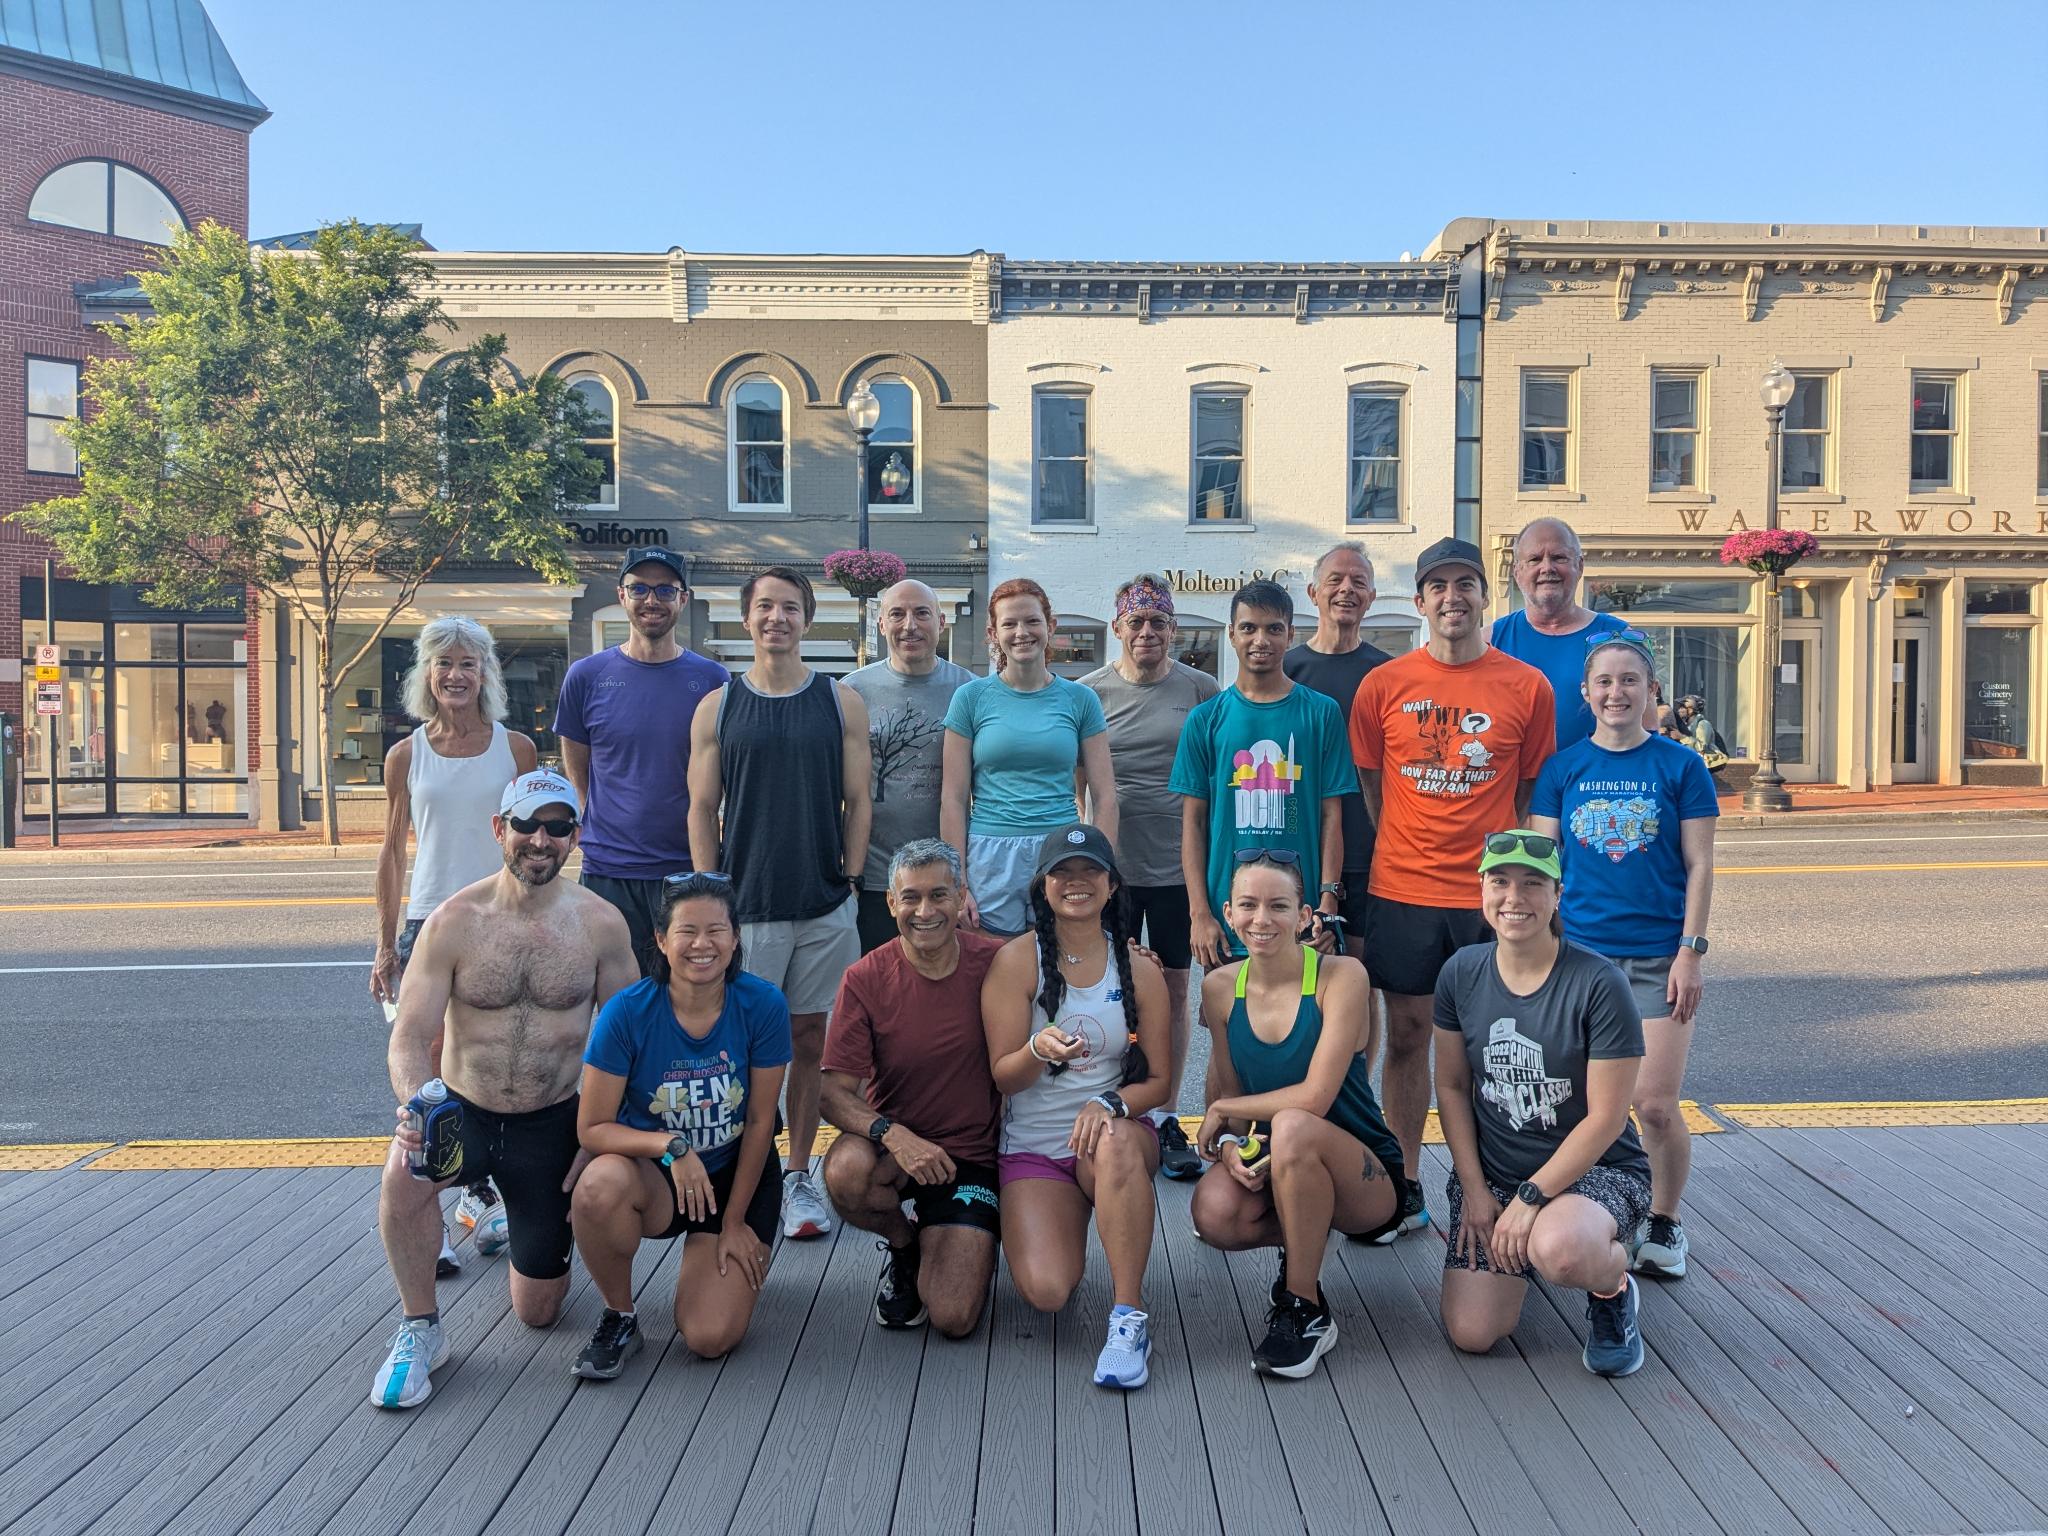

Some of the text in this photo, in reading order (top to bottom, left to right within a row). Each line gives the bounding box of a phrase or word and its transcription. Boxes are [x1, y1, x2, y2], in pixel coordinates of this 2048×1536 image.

[565, 522, 669, 545] Poliform
[1163, 569, 1244, 592] Molteni
[1982, 681, 2010, 690] Custom
[1979, 690, 2013, 700] Cabinetry
[1401, 765, 1497, 782] HOW FAR IS THAT?
[1416, 779, 1472, 794] 13K/4M
[1579, 781, 1638, 792] WASHINGTON
[1235, 789, 1267, 829] DC
[1490, 1042, 1510, 1056] 2022
[1511, 1041, 1543, 1069] CAPITOL
[671, 1055, 719, 1069] CREDIT UNION
[663, 1063, 728, 1080] CHERRY BLOSSOM
[1512, 1067, 1545, 1083] HILL
[662, 1073, 731, 1109] TEN
[1515, 1080, 1572, 1120] CLASSIC
[664, 1100, 732, 1130] MILE
